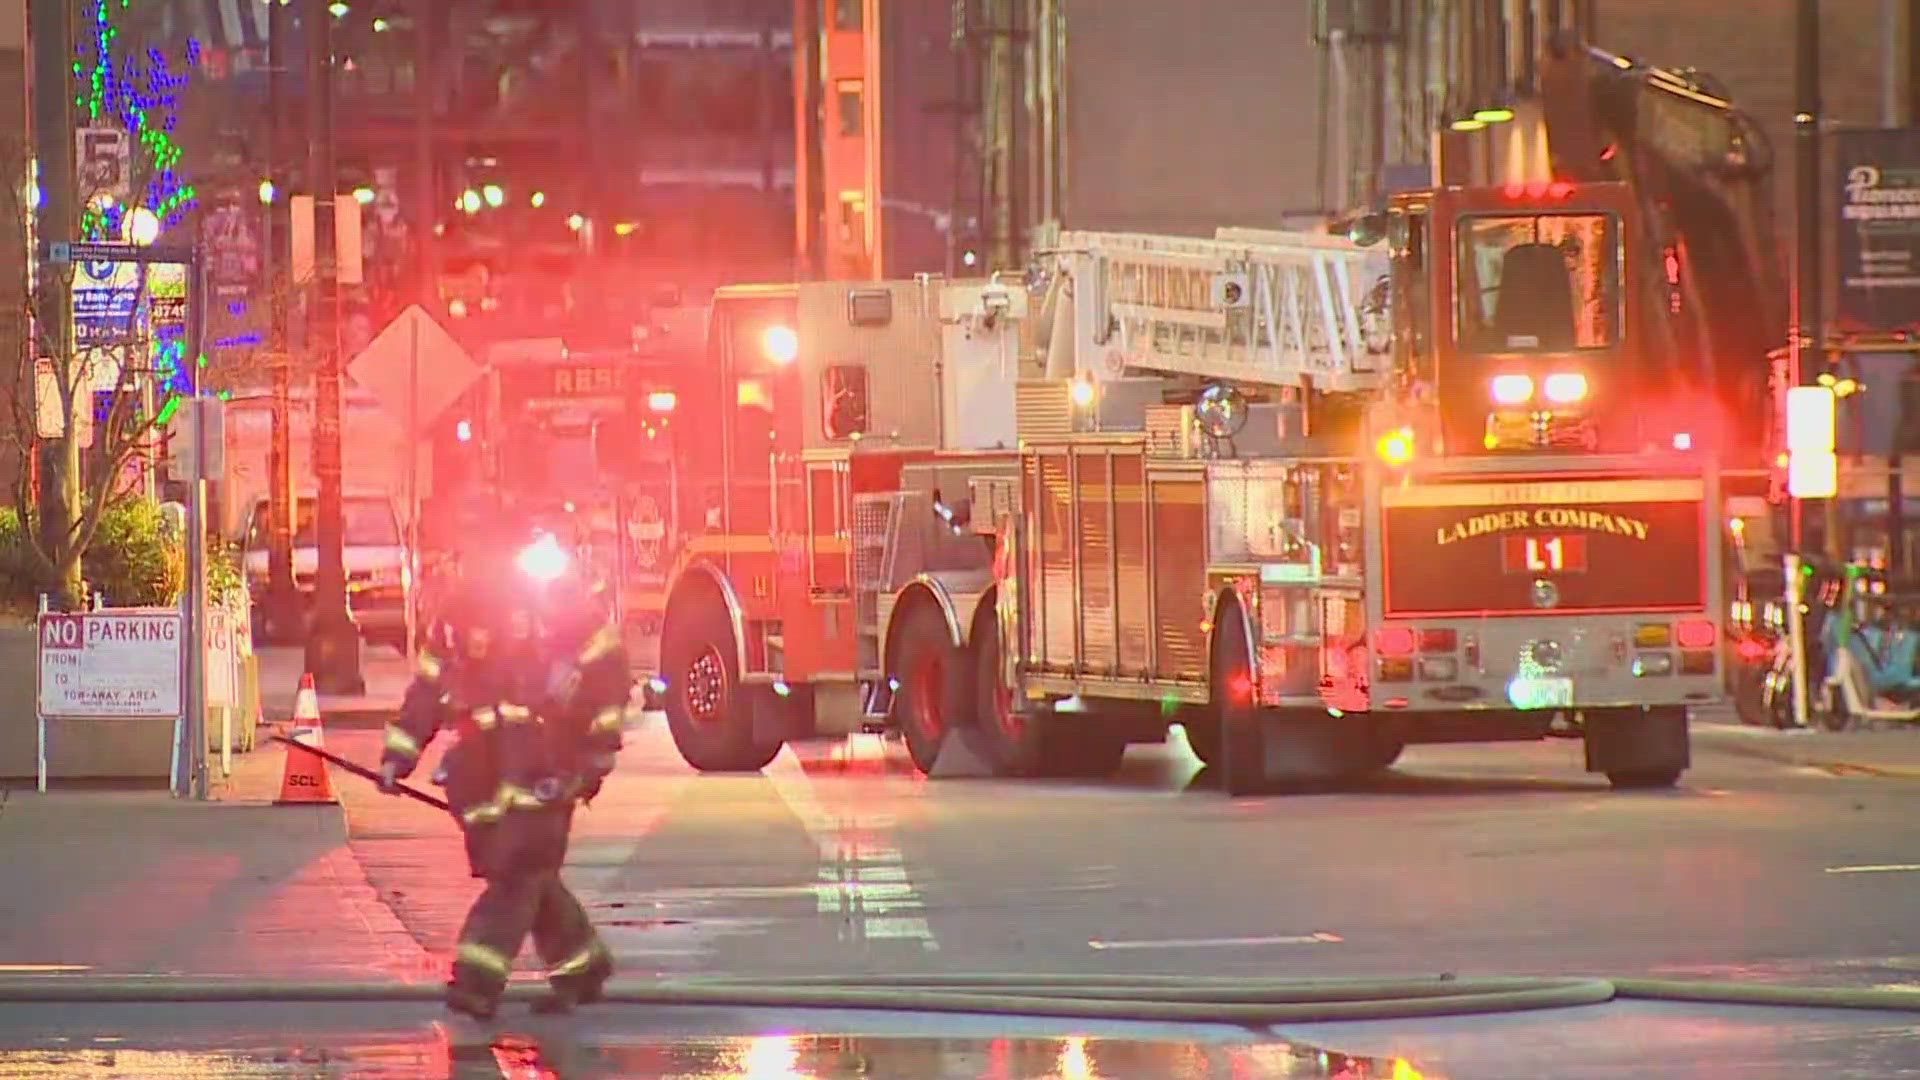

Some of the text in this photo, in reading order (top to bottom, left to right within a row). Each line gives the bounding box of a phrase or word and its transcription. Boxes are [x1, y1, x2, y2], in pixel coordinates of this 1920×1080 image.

[1437, 508, 1649, 545] LADDER COMPANY
[1526, 536, 1563, 571] L1
[45, 619, 174, 645] NO PARKING
[46, 653, 77, 665] FROM
[64, 689, 157, 701] TOW-AWAY AREA
[289, 774, 320, 787] SCL
